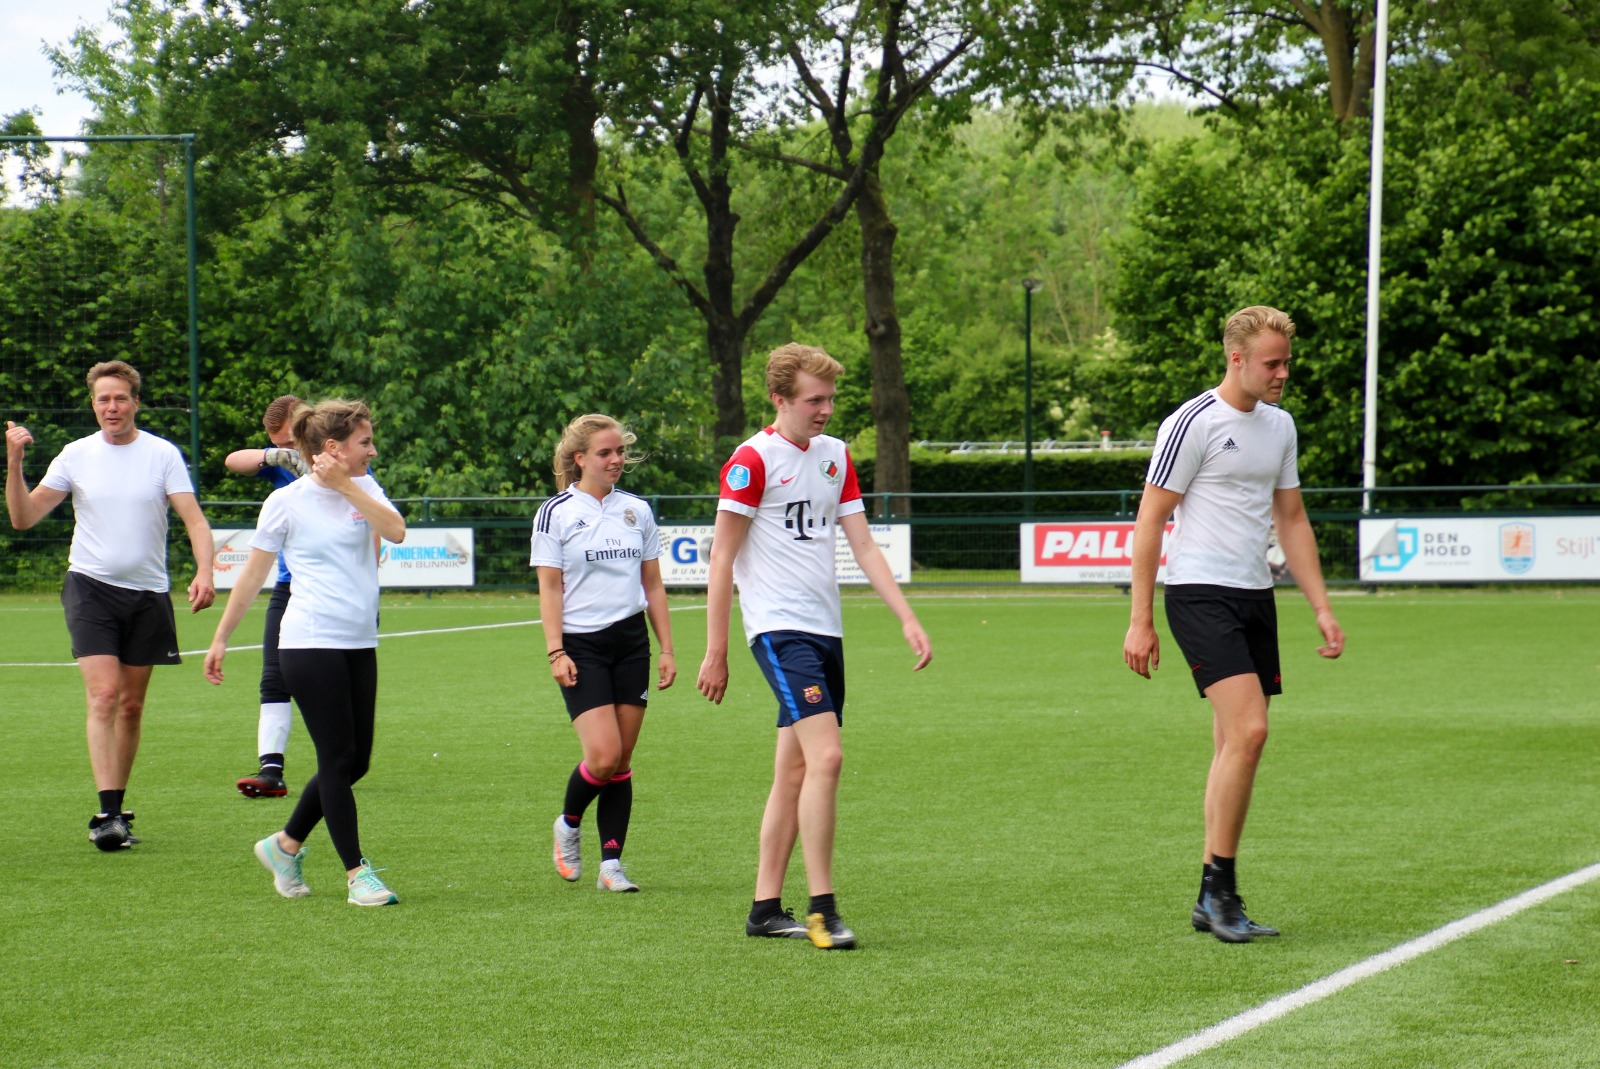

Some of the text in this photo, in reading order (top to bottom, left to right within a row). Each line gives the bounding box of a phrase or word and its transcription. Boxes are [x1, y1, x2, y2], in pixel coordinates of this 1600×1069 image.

[1424, 533, 1458, 543] DEN
[1424, 546, 1471, 556] HOED
[1556, 536, 1600, 559] Stijl
[585, 547, 641, 562] Emirates
